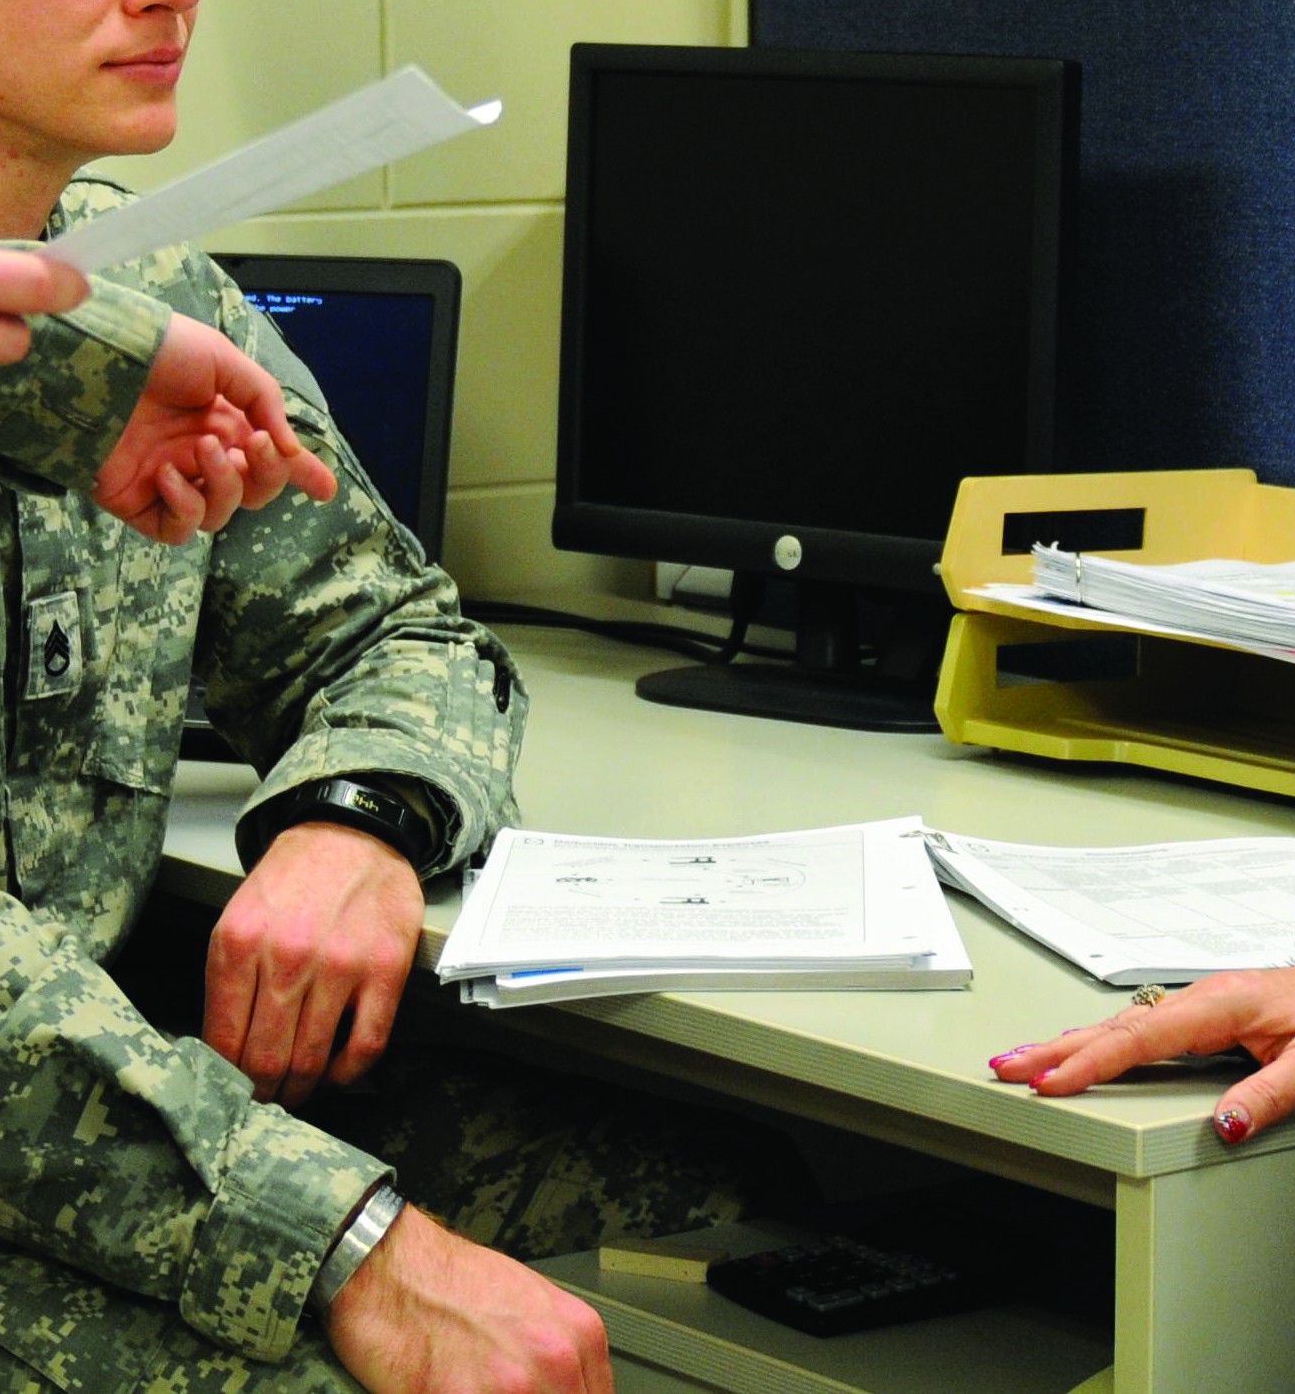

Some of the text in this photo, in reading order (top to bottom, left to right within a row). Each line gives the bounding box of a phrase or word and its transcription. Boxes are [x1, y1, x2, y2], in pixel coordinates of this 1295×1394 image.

[266, 293, 282, 303] The
[285, 294, 323, 305] battery
[269, 305, 296, 313] power
